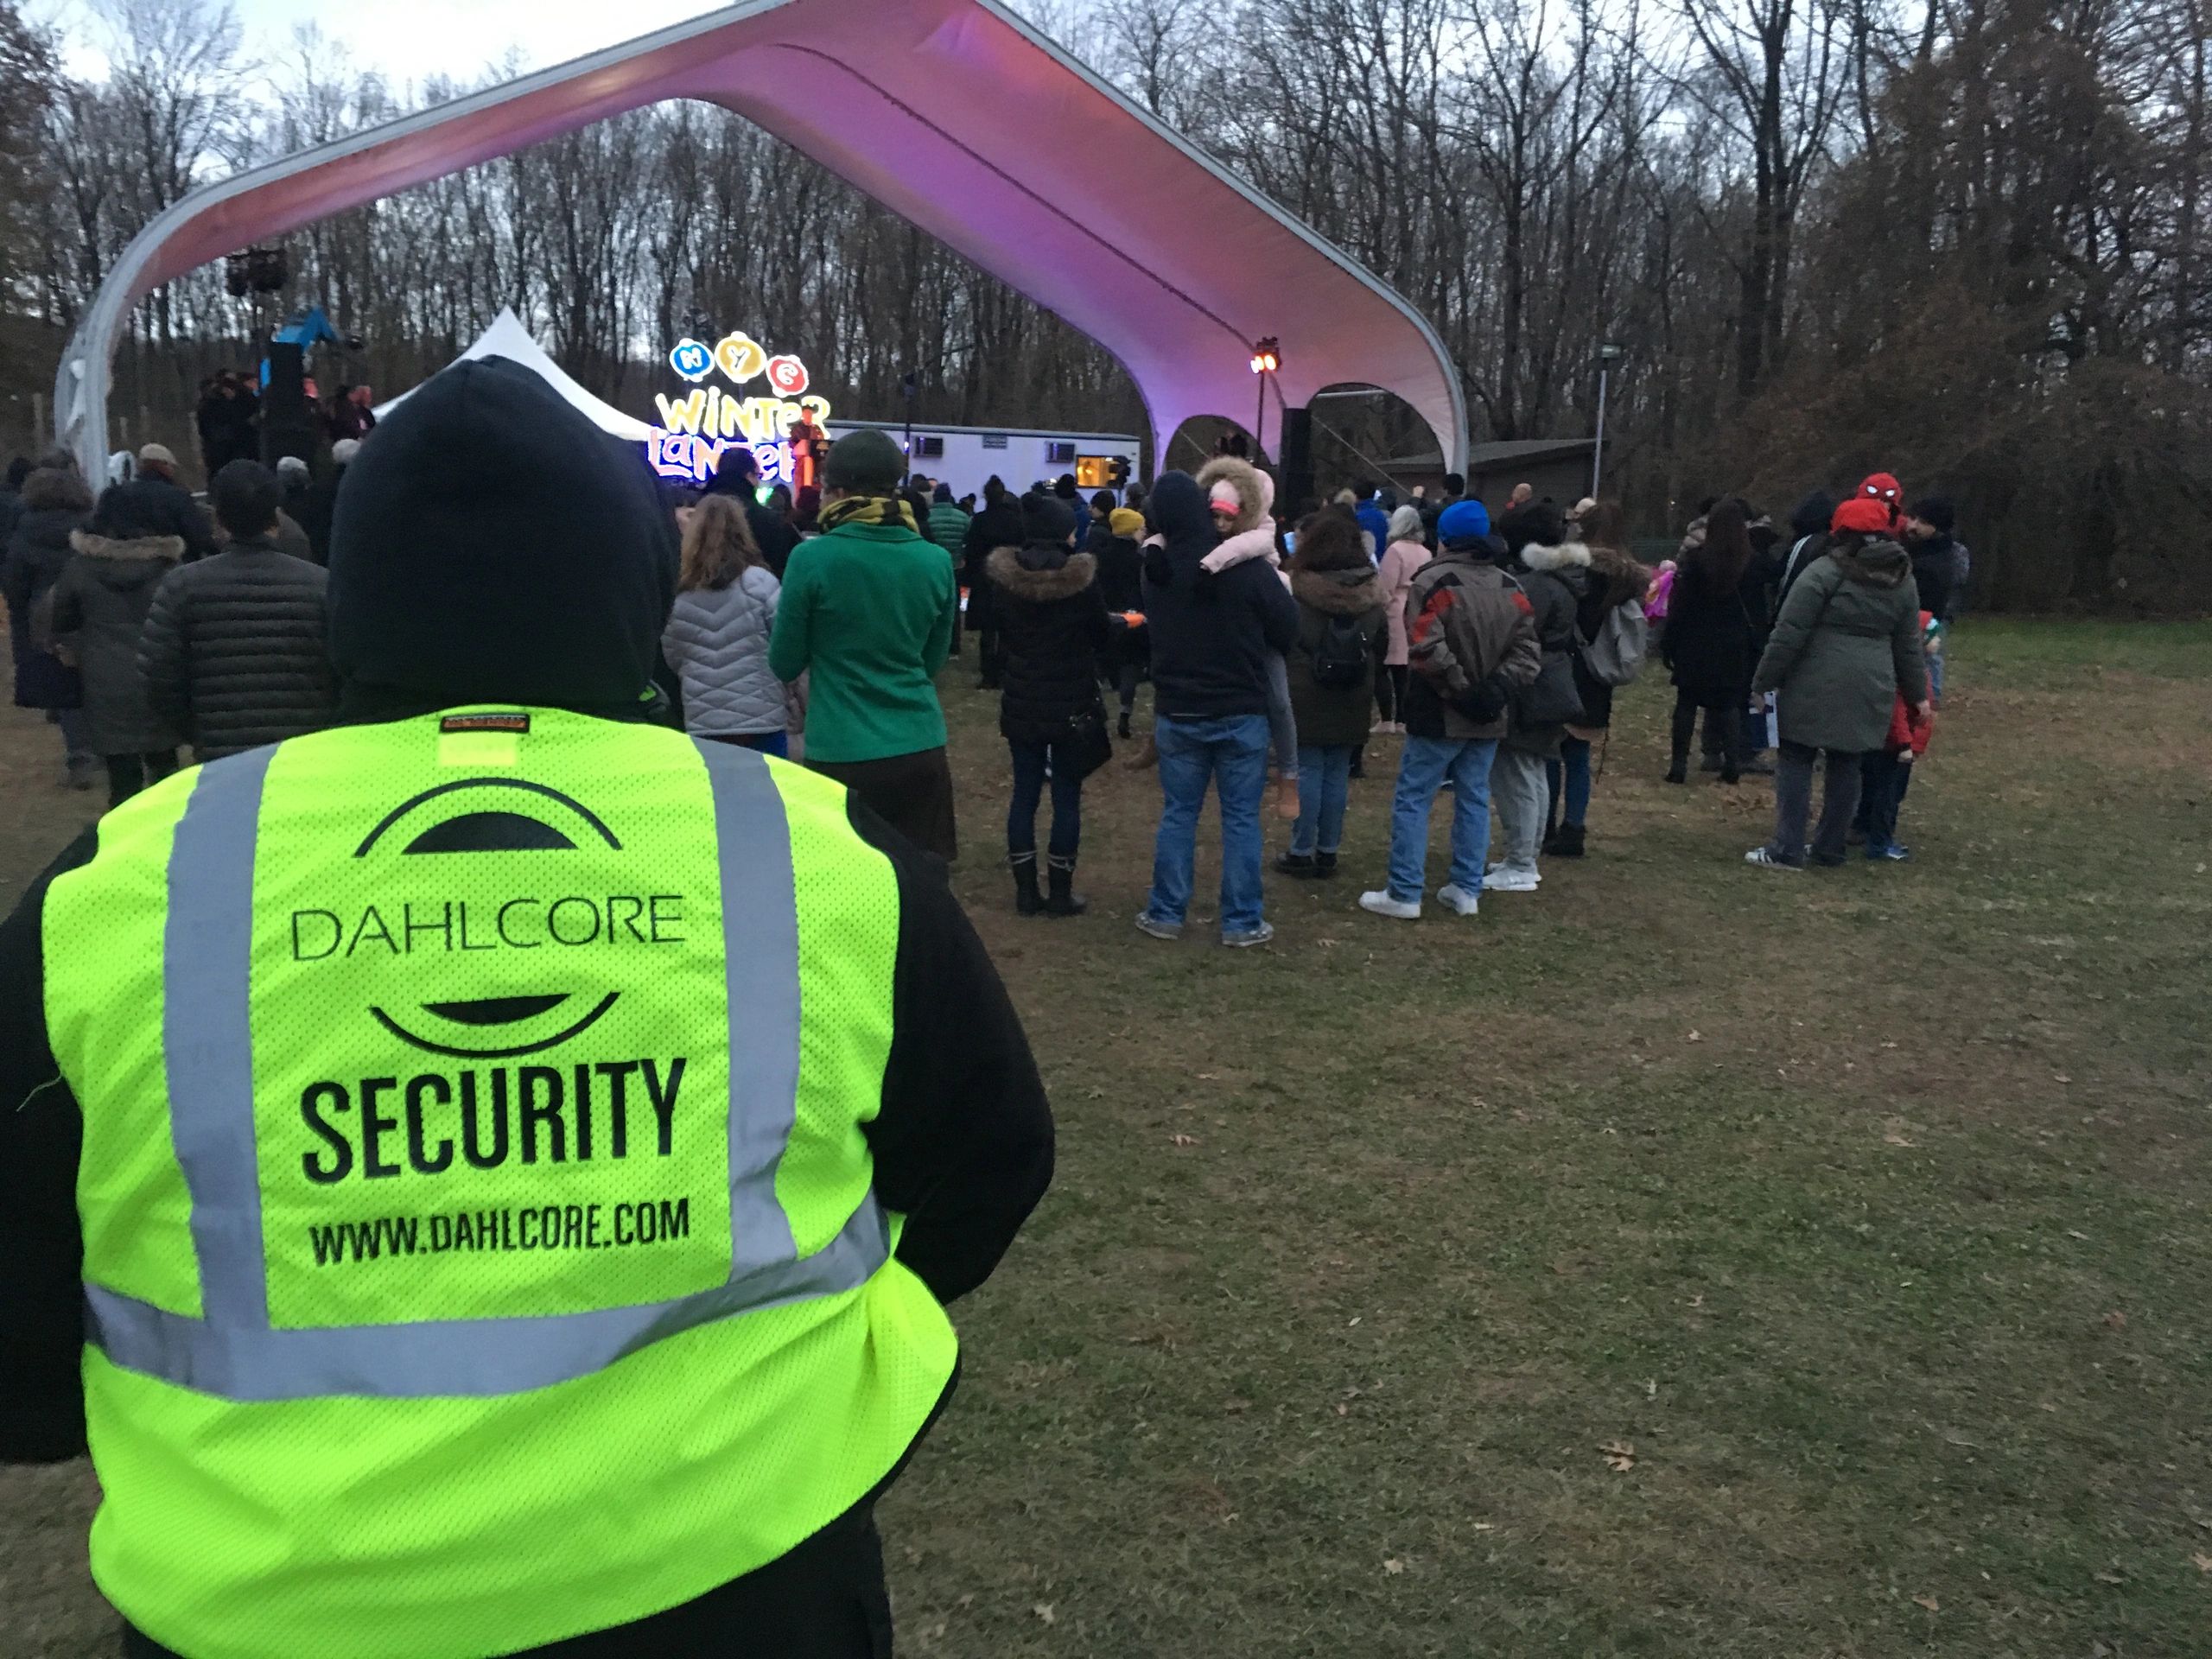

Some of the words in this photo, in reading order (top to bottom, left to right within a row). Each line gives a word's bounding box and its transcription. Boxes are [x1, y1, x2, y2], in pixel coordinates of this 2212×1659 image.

[677, 343, 802, 387] NYC
[290, 893, 687, 963] DAHLCORE
[300, 1057, 688, 1185] SECURITY
[308, 1198, 690, 1267] WWW.DAHLCORE.COM
